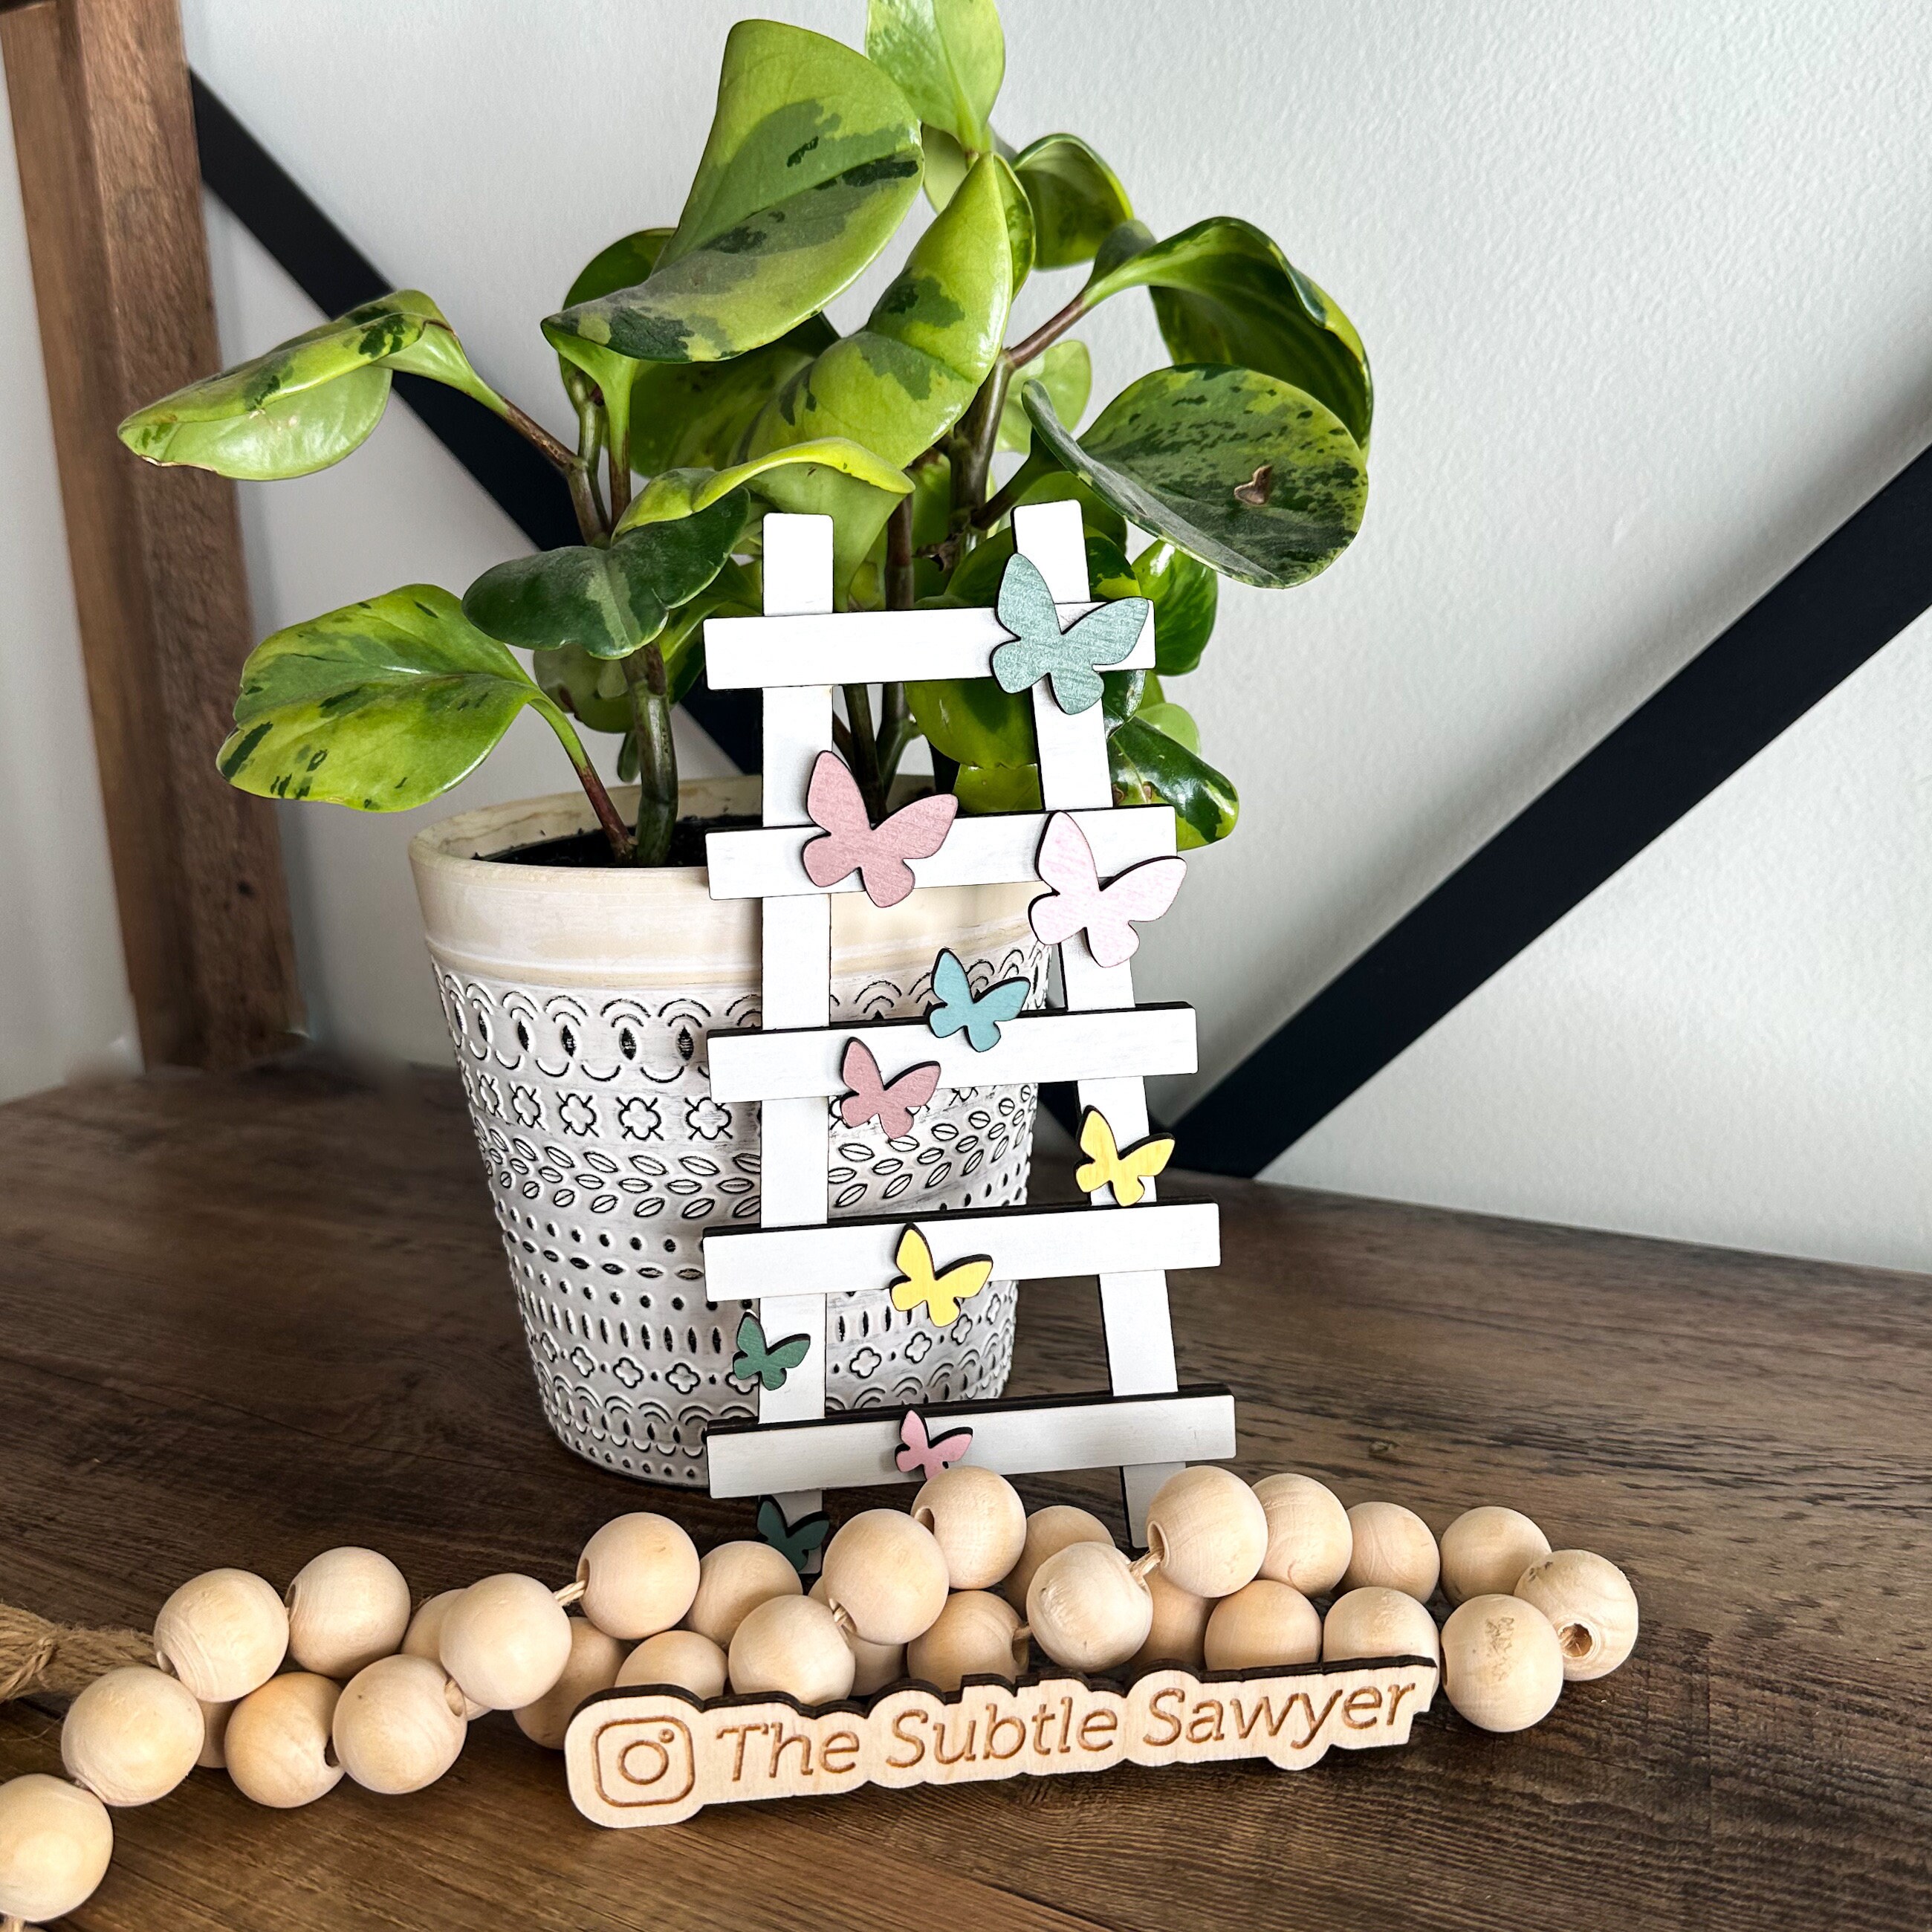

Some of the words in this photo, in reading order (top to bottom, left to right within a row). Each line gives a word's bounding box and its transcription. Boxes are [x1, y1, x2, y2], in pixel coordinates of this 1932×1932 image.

[715, 1720, 860, 1781] The
[886, 1695, 1118, 1769] Subtle
[1142, 1680, 1416, 1749] Sawyer
